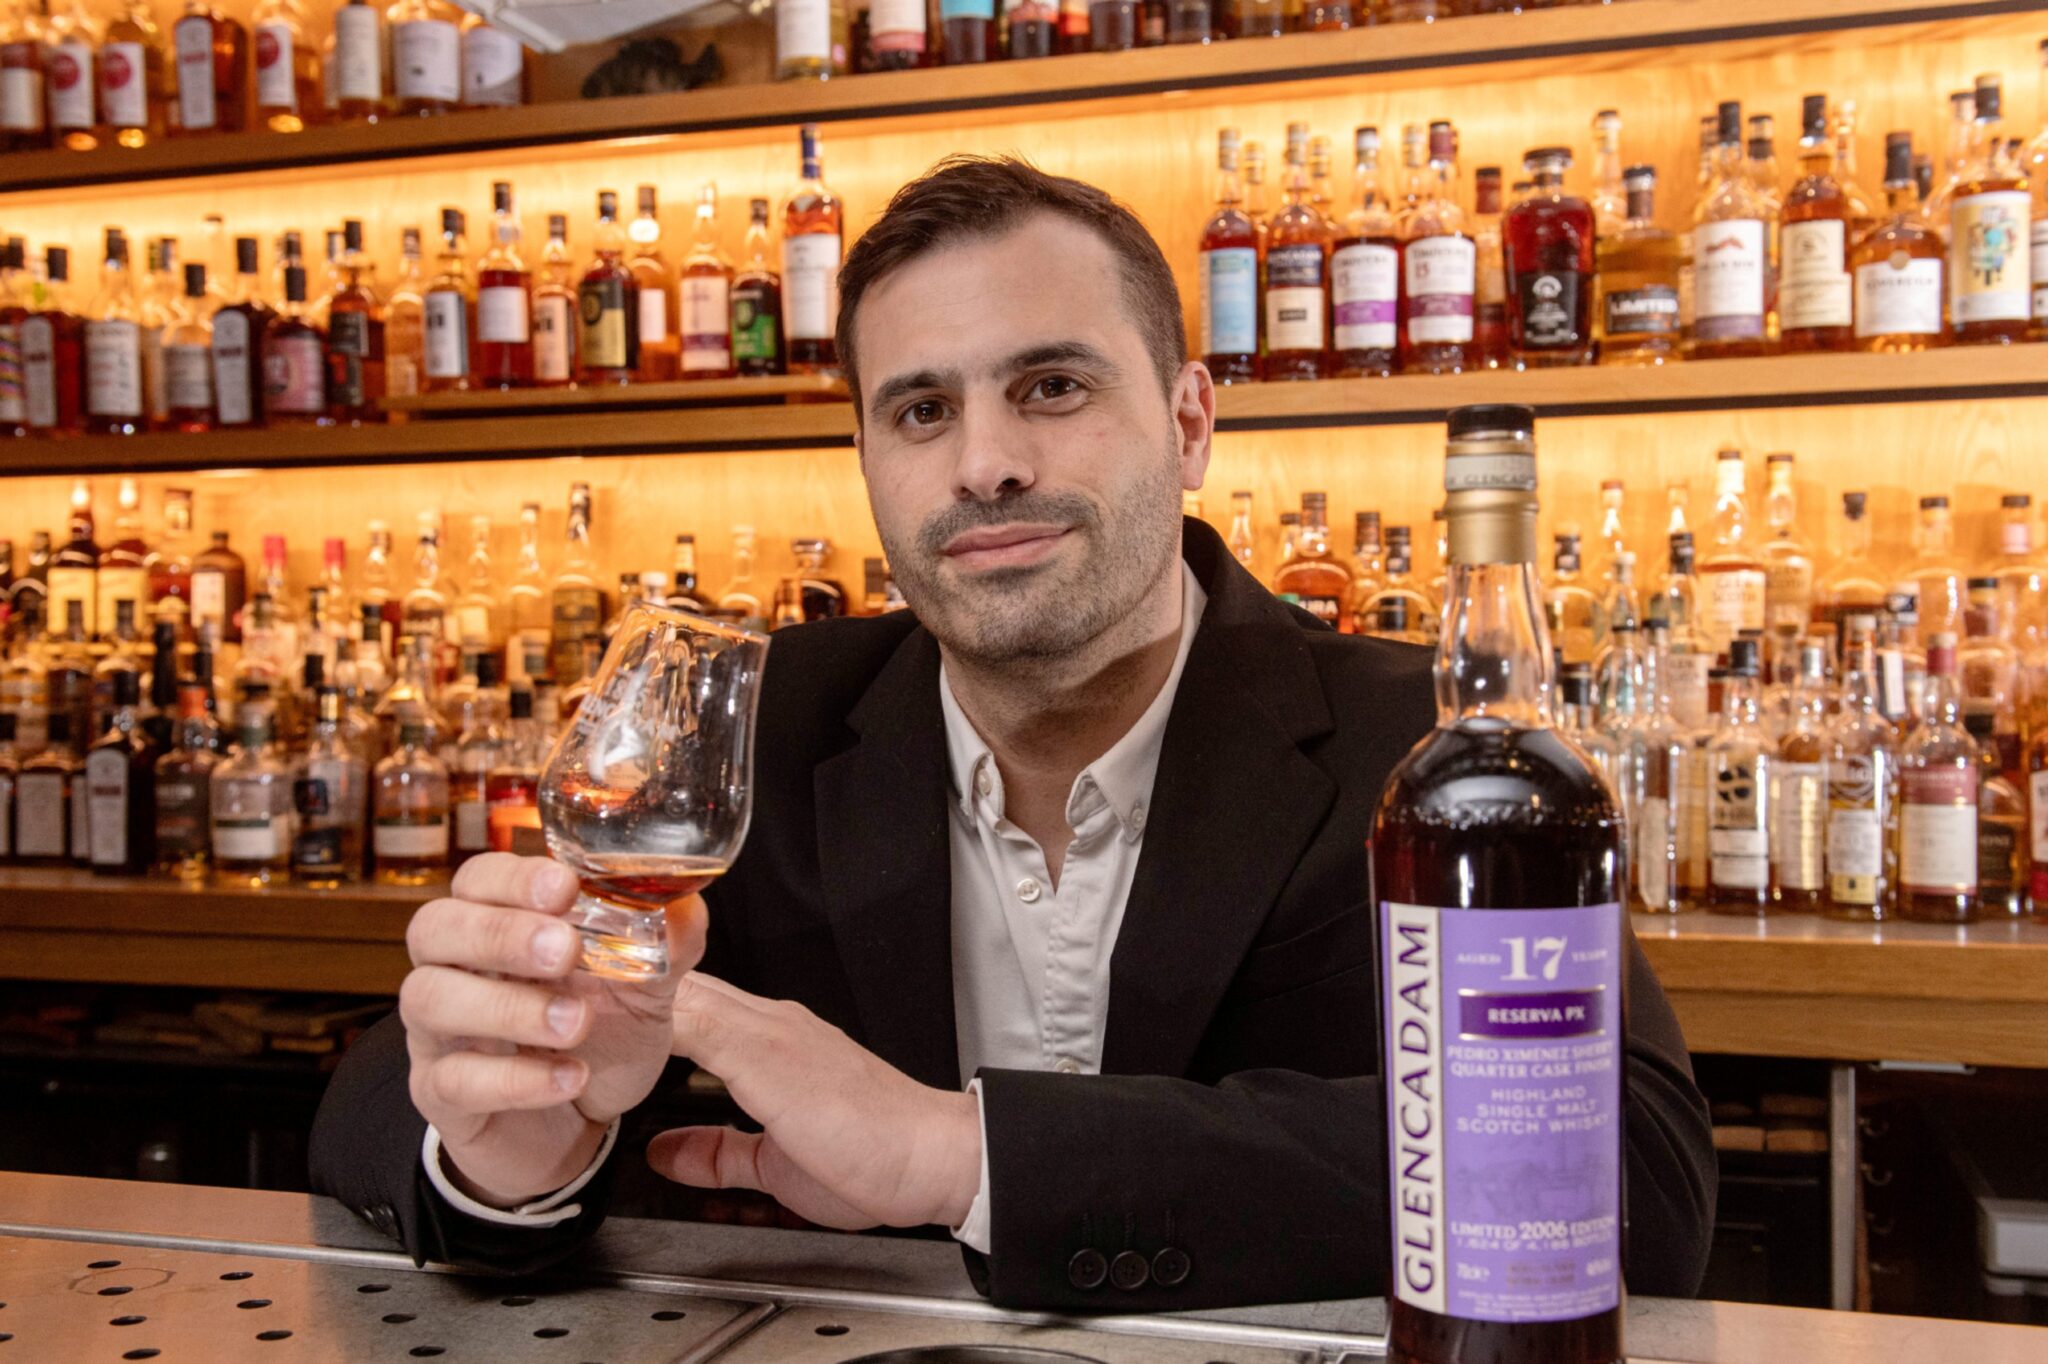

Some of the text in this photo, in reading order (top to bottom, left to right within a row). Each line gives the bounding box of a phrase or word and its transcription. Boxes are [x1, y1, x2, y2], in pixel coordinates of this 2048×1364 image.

[1500, 935, 1568, 981] 17
[1488, 1006, 1586, 1023] RESERVA PX
[1447, 1045, 1498, 1061] PEDRO
[1451, 1057, 1612, 1078] QUARTER CASK FINISH
[1491, 1085, 1586, 1102] HIGHLAND
[1397, 923, 1435, 1294] GLENCADAM
[1477, 1099, 1597, 1119] SINGLE MALT
[1457, 1113, 1608, 1135] SCOTCH WHISKY
[1451, 1216, 1616, 1240] LIMITED 2006 EDITION
